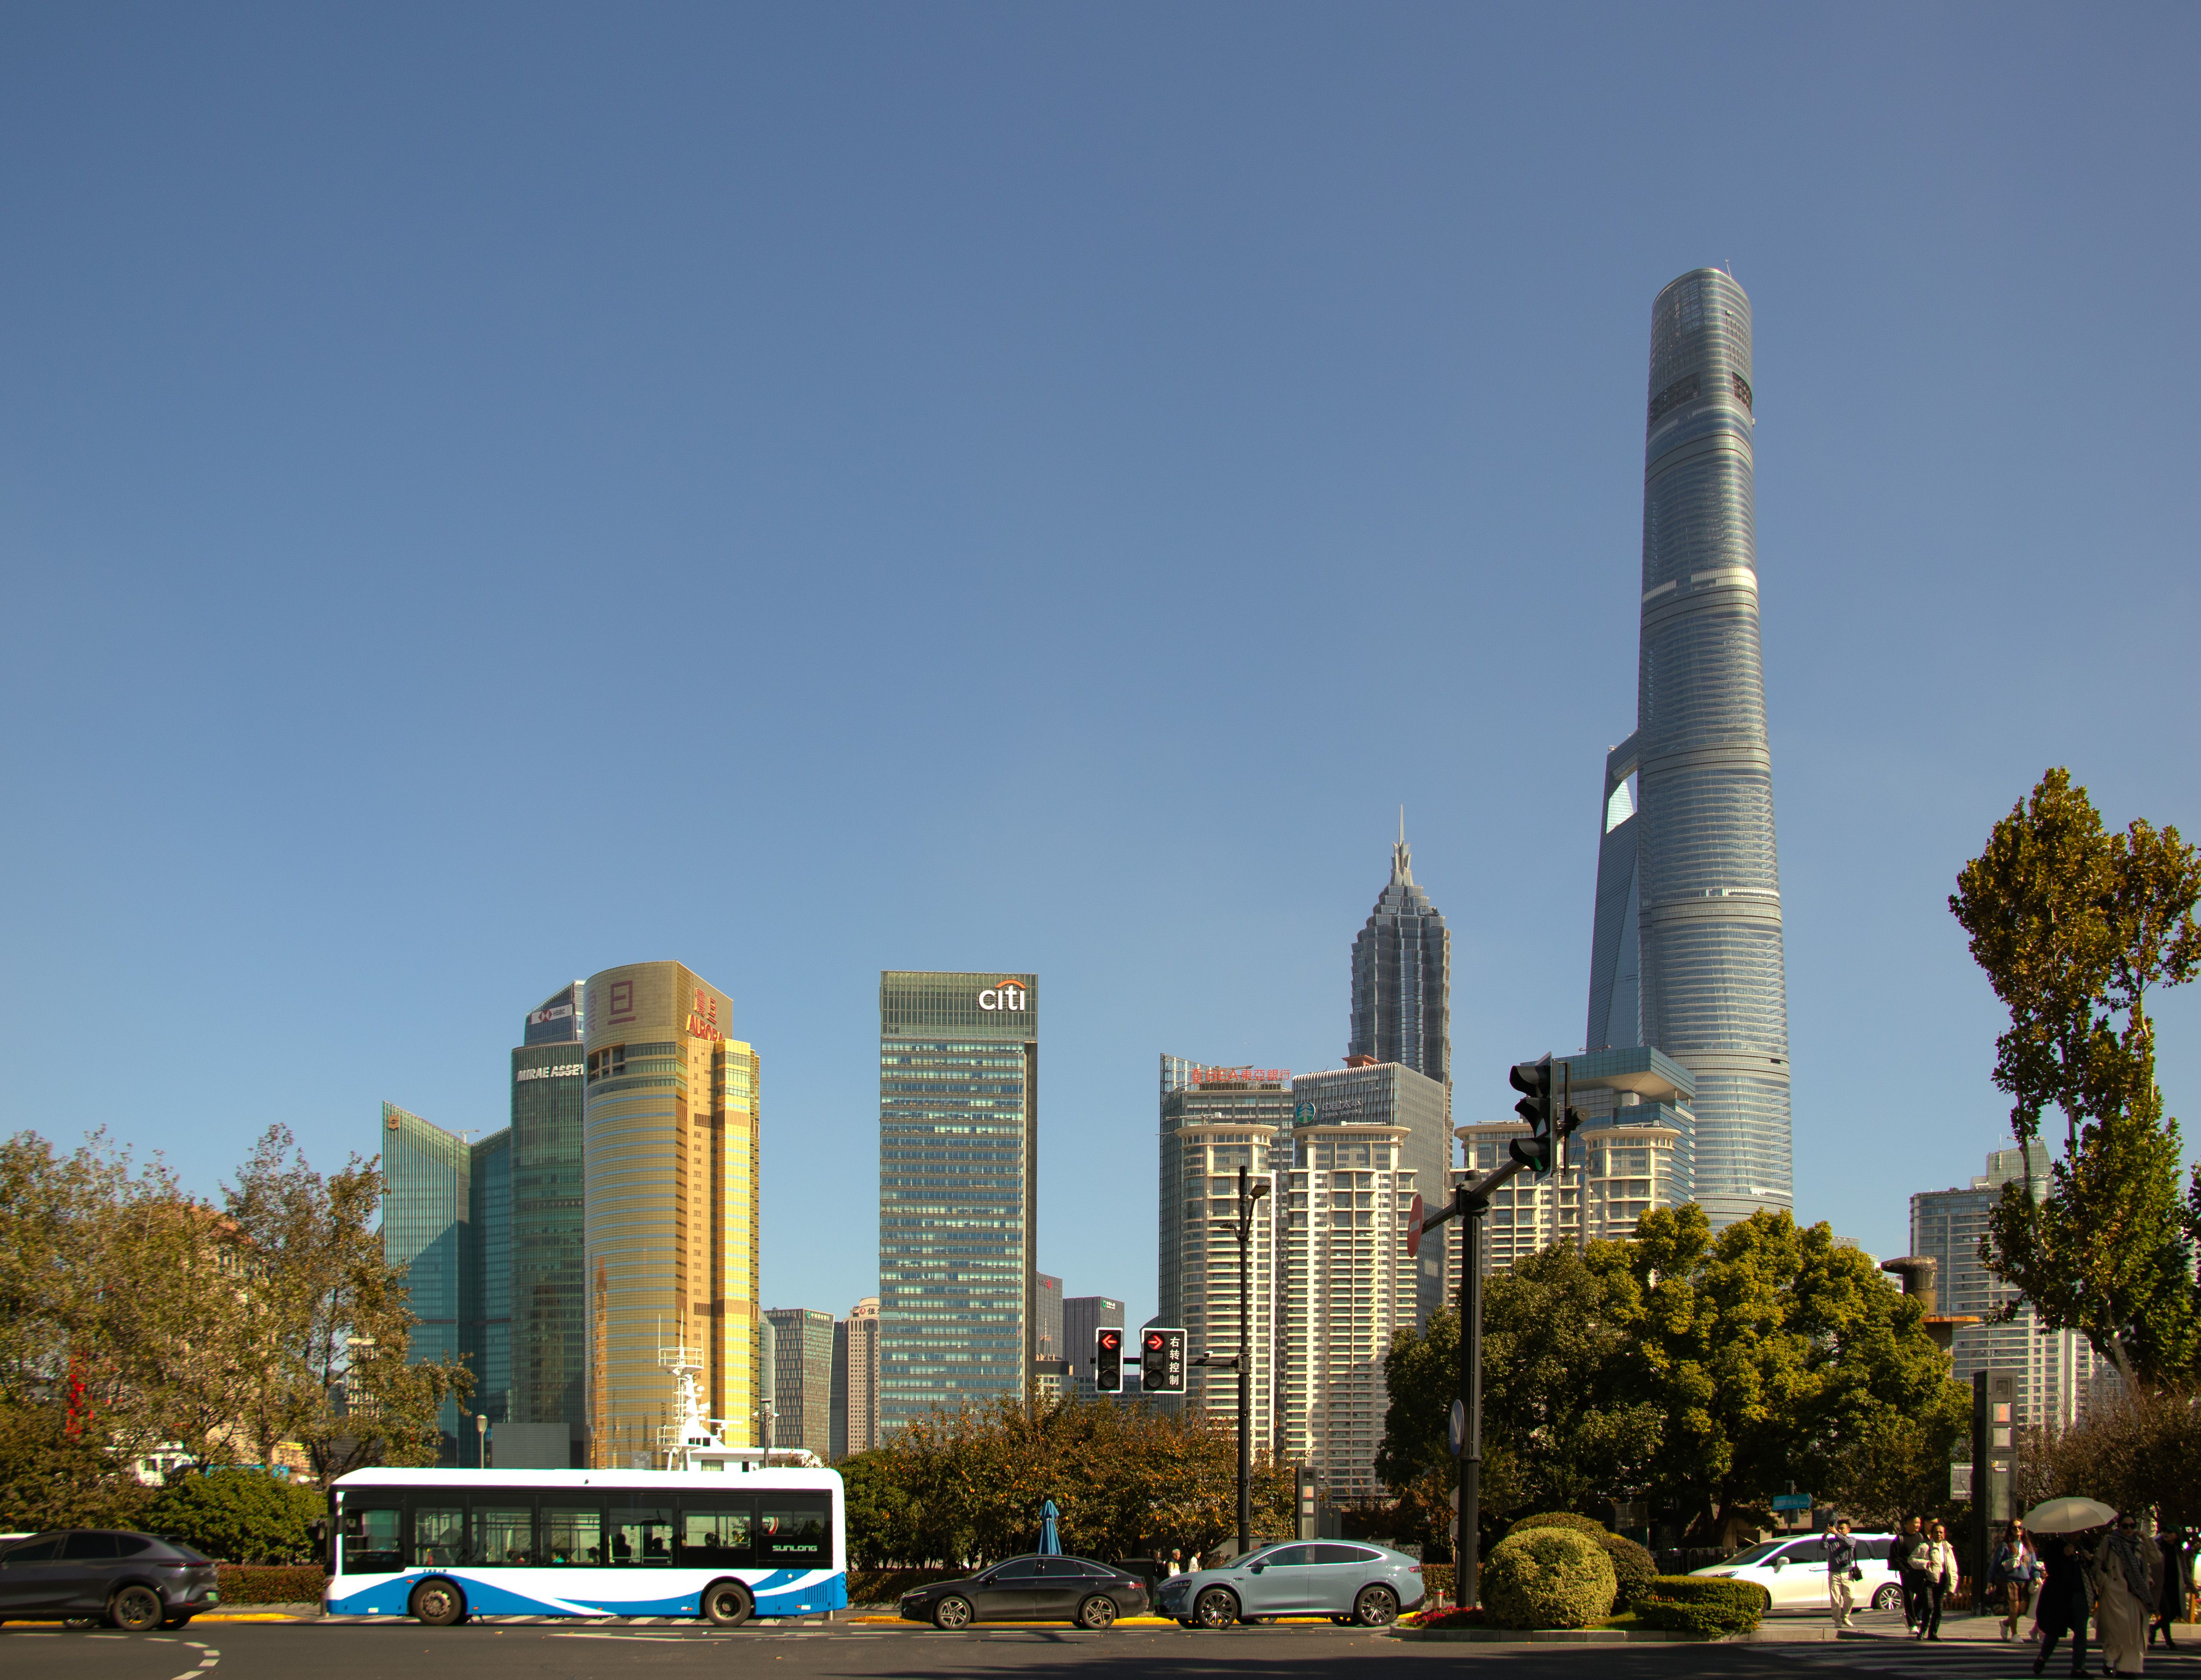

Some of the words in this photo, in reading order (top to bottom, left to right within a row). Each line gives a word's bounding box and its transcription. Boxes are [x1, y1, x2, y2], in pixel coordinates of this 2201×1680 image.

[694, 988, 717, 1025] 震旦
[979, 985, 1024, 1010] citi
[517, 1067, 549, 1081] MIRAE
[1206, 1069, 1238, 1081] BEA
[1241, 1069, 1291, 1080] 東亞銀行
[1322, 1098, 1361, 1112] 中国太平
[1169, 1336, 1180, 1386] 右转控制
